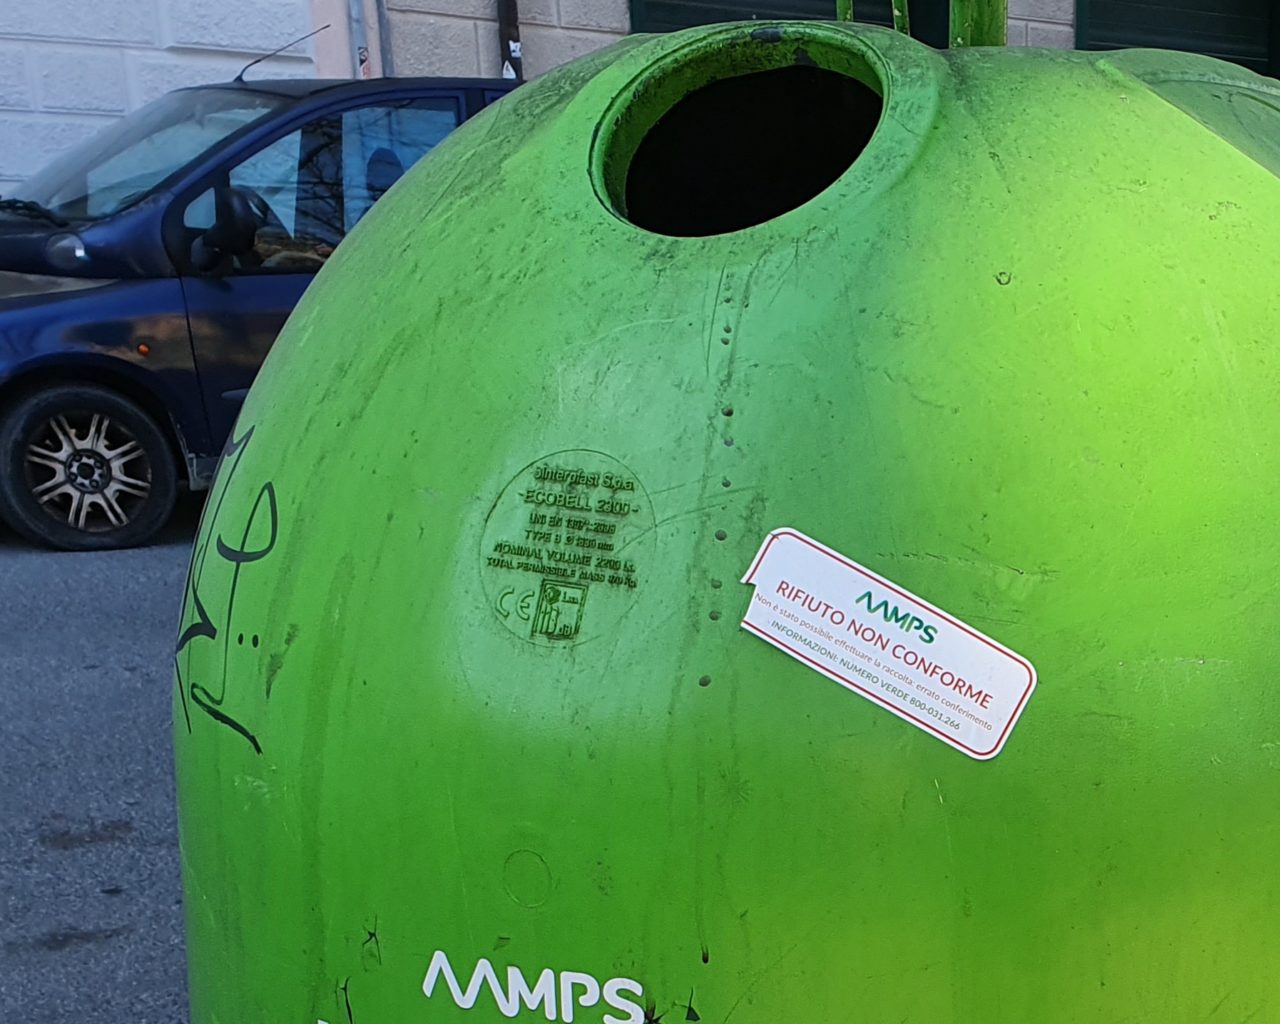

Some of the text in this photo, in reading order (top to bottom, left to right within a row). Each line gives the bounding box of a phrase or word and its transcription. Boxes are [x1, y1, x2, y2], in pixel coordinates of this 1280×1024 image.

[493, 542, 543, 561] NOMINAL
[546, 549, 592, 567] VOLUME
[525, 528, 552, 543] TYPE
[486, 556, 515, 570] TOTAL
[578, 570, 605, 583] MASS
[754, 593, 993, 732] Non è stato possibile effettuare la raccolta: errato conferimento
[770, 619, 839, 663] INFORMAZIONI:
[839, 657, 880, 685] NUMERO
[880, 678, 911, 702] VERDE
[776, 580, 994, 710] RIFIUTO NON CONFORME
